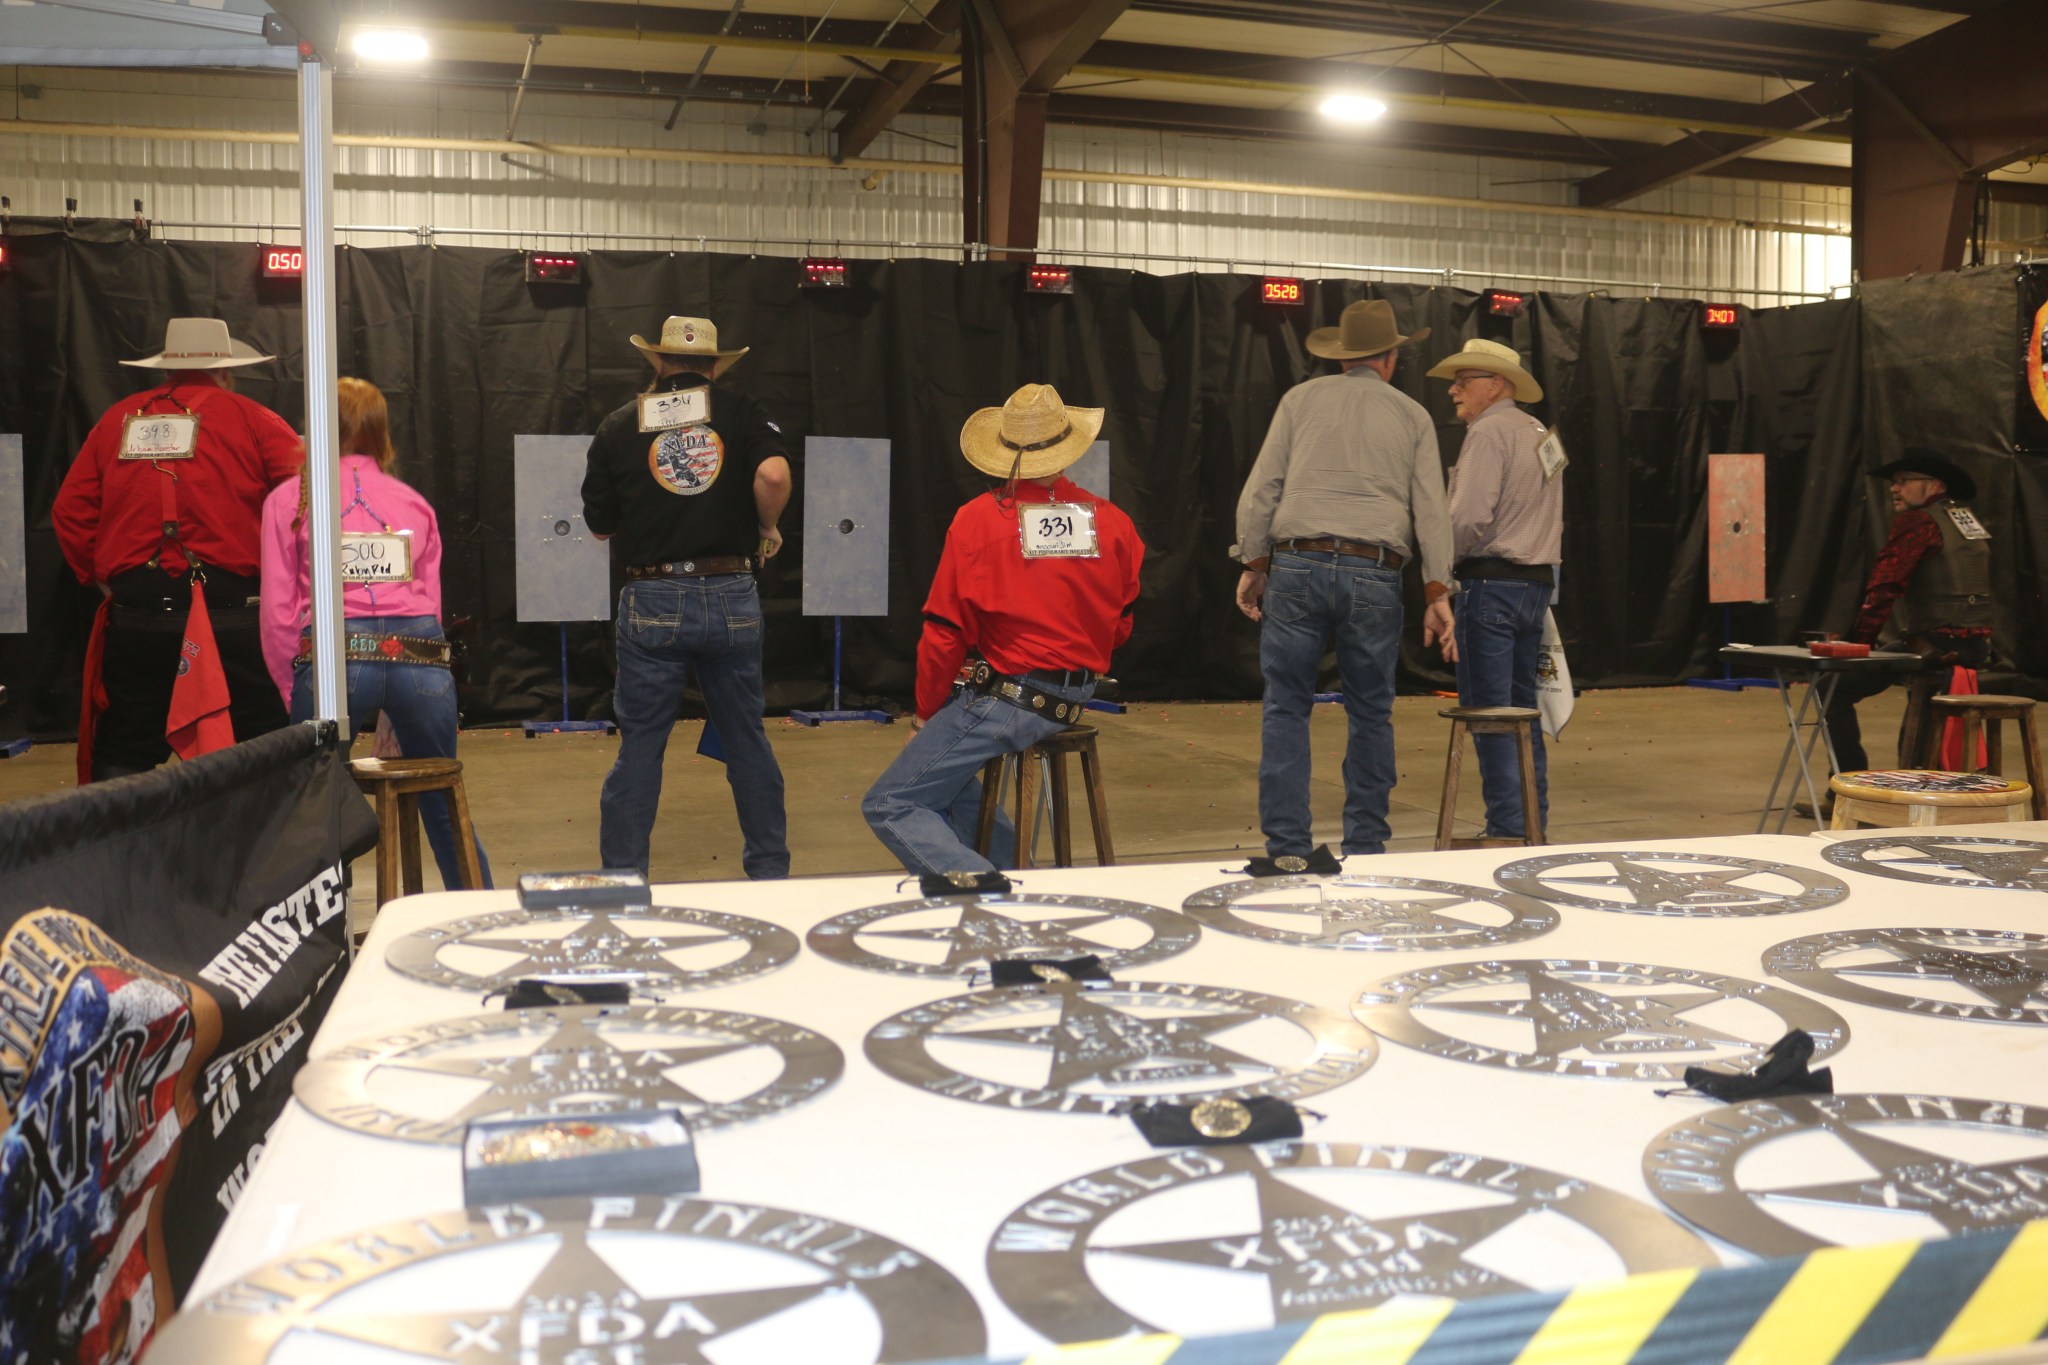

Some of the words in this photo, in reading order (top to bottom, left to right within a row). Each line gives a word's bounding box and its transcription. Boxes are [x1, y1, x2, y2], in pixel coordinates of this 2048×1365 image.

[350, 638, 377, 653] RED
[20, 1009, 191, 1248] XFDA
[994, 1149, 1225, 1251] WORLD
[1249, 1142, 1589, 1201] FINALS
[203, 1202, 546, 1314] WORLD
[588, 1195, 920, 1279] FINALS
[1209, 1220, 1460, 1270] XFDA
[446, 1300, 719, 1354] XFDA
